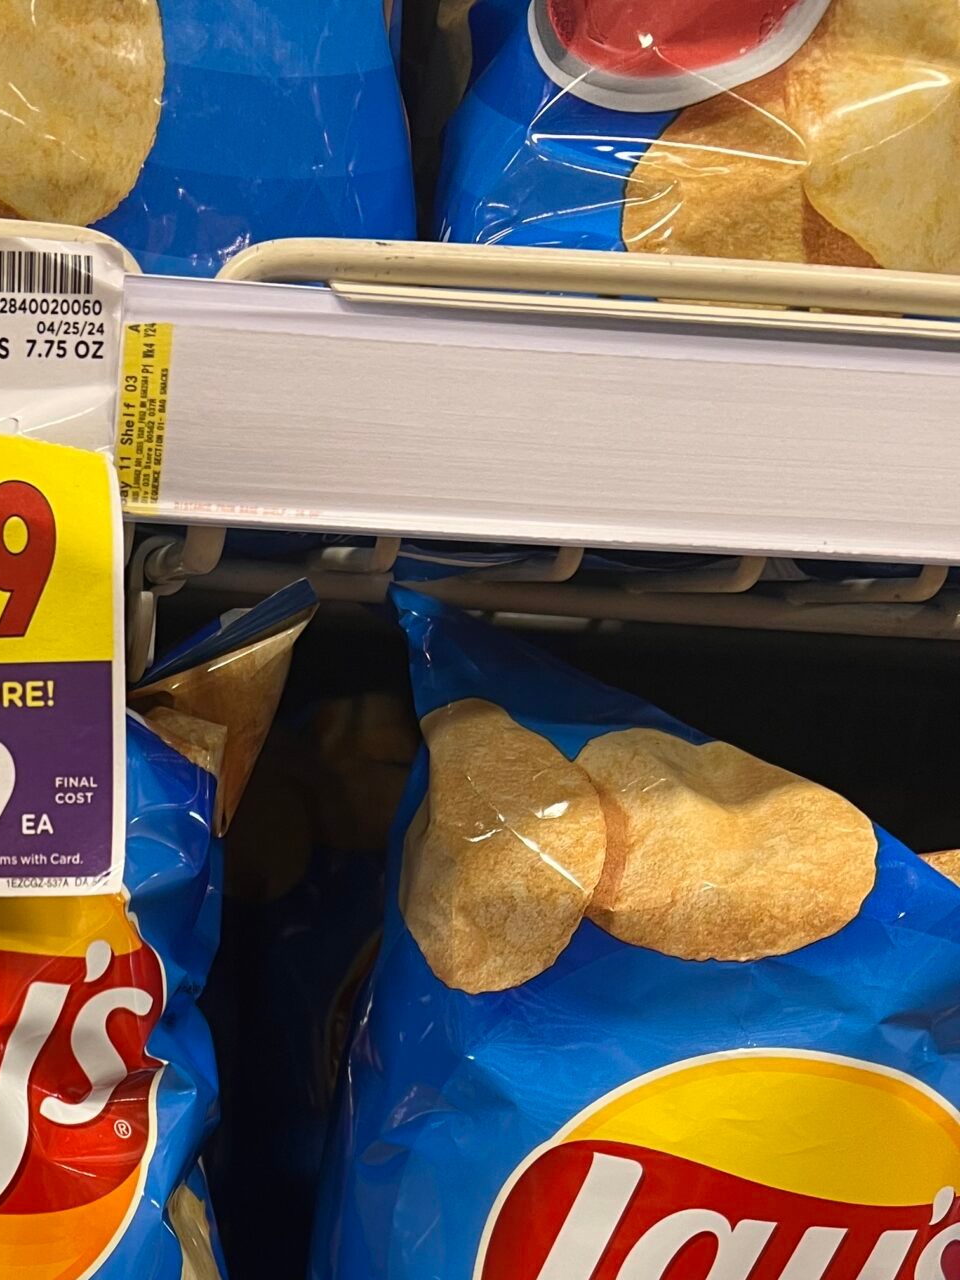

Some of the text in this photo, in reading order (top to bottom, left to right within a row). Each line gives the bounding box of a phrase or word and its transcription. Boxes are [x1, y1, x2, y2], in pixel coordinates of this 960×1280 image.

[37, 321, 105, 335] 04/25/24
[26, 340, 67, 359] 7.75
[74, 341, 104, 359] OZ
[125, 375, 138, 392] 03
[120, 402, 136, 446] Shelf
[55, 777, 98, 788] FINAL
[55, 792, 93, 804] COST
[22, 815, 54, 835] EA
[20, 853, 48, 865] with
[50, 853, 84, 865] Card.
